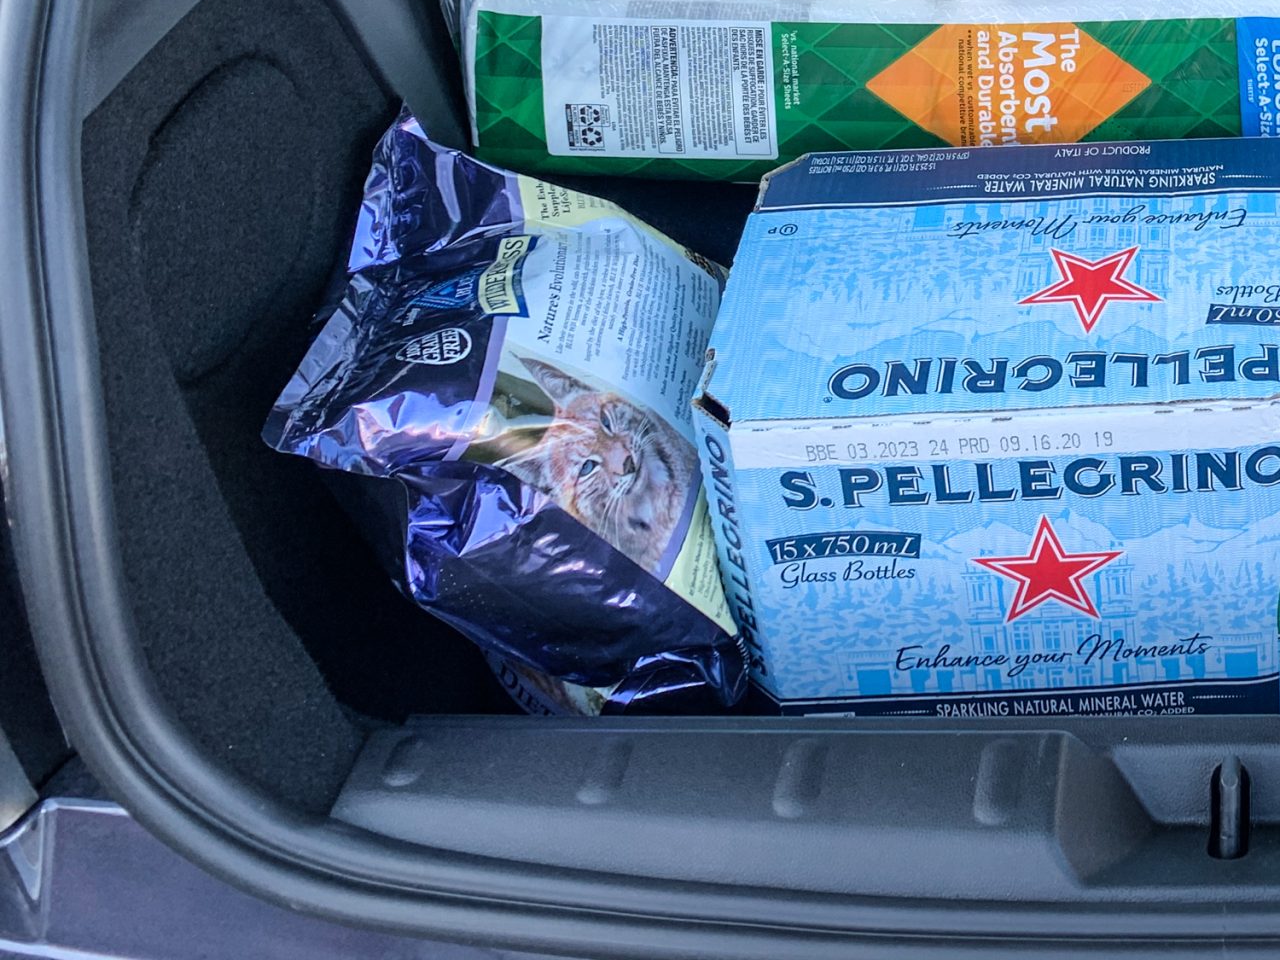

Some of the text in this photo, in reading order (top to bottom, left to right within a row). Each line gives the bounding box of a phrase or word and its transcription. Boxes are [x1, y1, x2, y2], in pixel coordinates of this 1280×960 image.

[652, 28, 660, 47] FUERA
[739, 29, 747, 42] SAC
[747, 29, 755, 56] RISQUES
[653, 48, 661, 60] DEL
[668, 27, 679, 79] ADVERTENCIA:
[731, 28, 740, 72] DES ENFANTS.
[740, 43, 748, 60] HORS
[748, 57, 756, 66] DE
[1059, 29, 1080, 73] The
[654, 61, 663, 89] ALCANCE
[740, 61, 748, 69] DE
[740, 70, 748, 78] LA
[781, 33, 792, 110] Select-A-Size Sheets
[791, 45, 801, 105] national market
[662, 63, 671, 98] MANTENGA
[748, 66, 758, 109] SUFFOCATION,
[755, 29, 767, 140] MISE EN GARDE POUR ÉVITER LES
[957, 39, 967, 125] national competitive
[978, 31, 997, 148] and Durable
[1023, 32, 1058, 133] Most
[664, 99, 672, 115] ESTA
[671, 97, 680, 118] EVITAR
[742, 103, 750, 115] DES
[665, 115, 673, 135] BOLSA
[673, 119, 681, 127] EL
[751, 110, 759, 135] GARDER
[674, 128, 683, 152] PELIGRO
[744, 136, 752, 144] ET
[1055, 145, 1150, 158] PRODUCT OF ITALY
[1034, 171, 1076, 179] NATURAL
[1182, 165, 1223, 173] NATURAL
[985, 173, 1216, 192] SPARKLING NATURAL MINERAL WATER
[540, 202, 549, 220] The
[560, 189, 572, 213] LifeS
[946, 204, 1247, 240] Enhance your Moments
[537, 293, 561, 344] Nature's
[1212, 305, 1253, 321] mL
[441, 330, 461, 359] FREE
[806, 431, 1114, 462] BBE 03.2023 24 PRD 09.16.20 19
[772, 535, 917, 562] 15 x 750 mL
[781, 558, 916, 589] Glass Bottles
[896, 633, 1214, 677] Enhance your Moments
[936, 692, 1186, 717] SPARKLING NATURAL MINERAL WATER
[1161, 705, 1196, 715] ADDED
